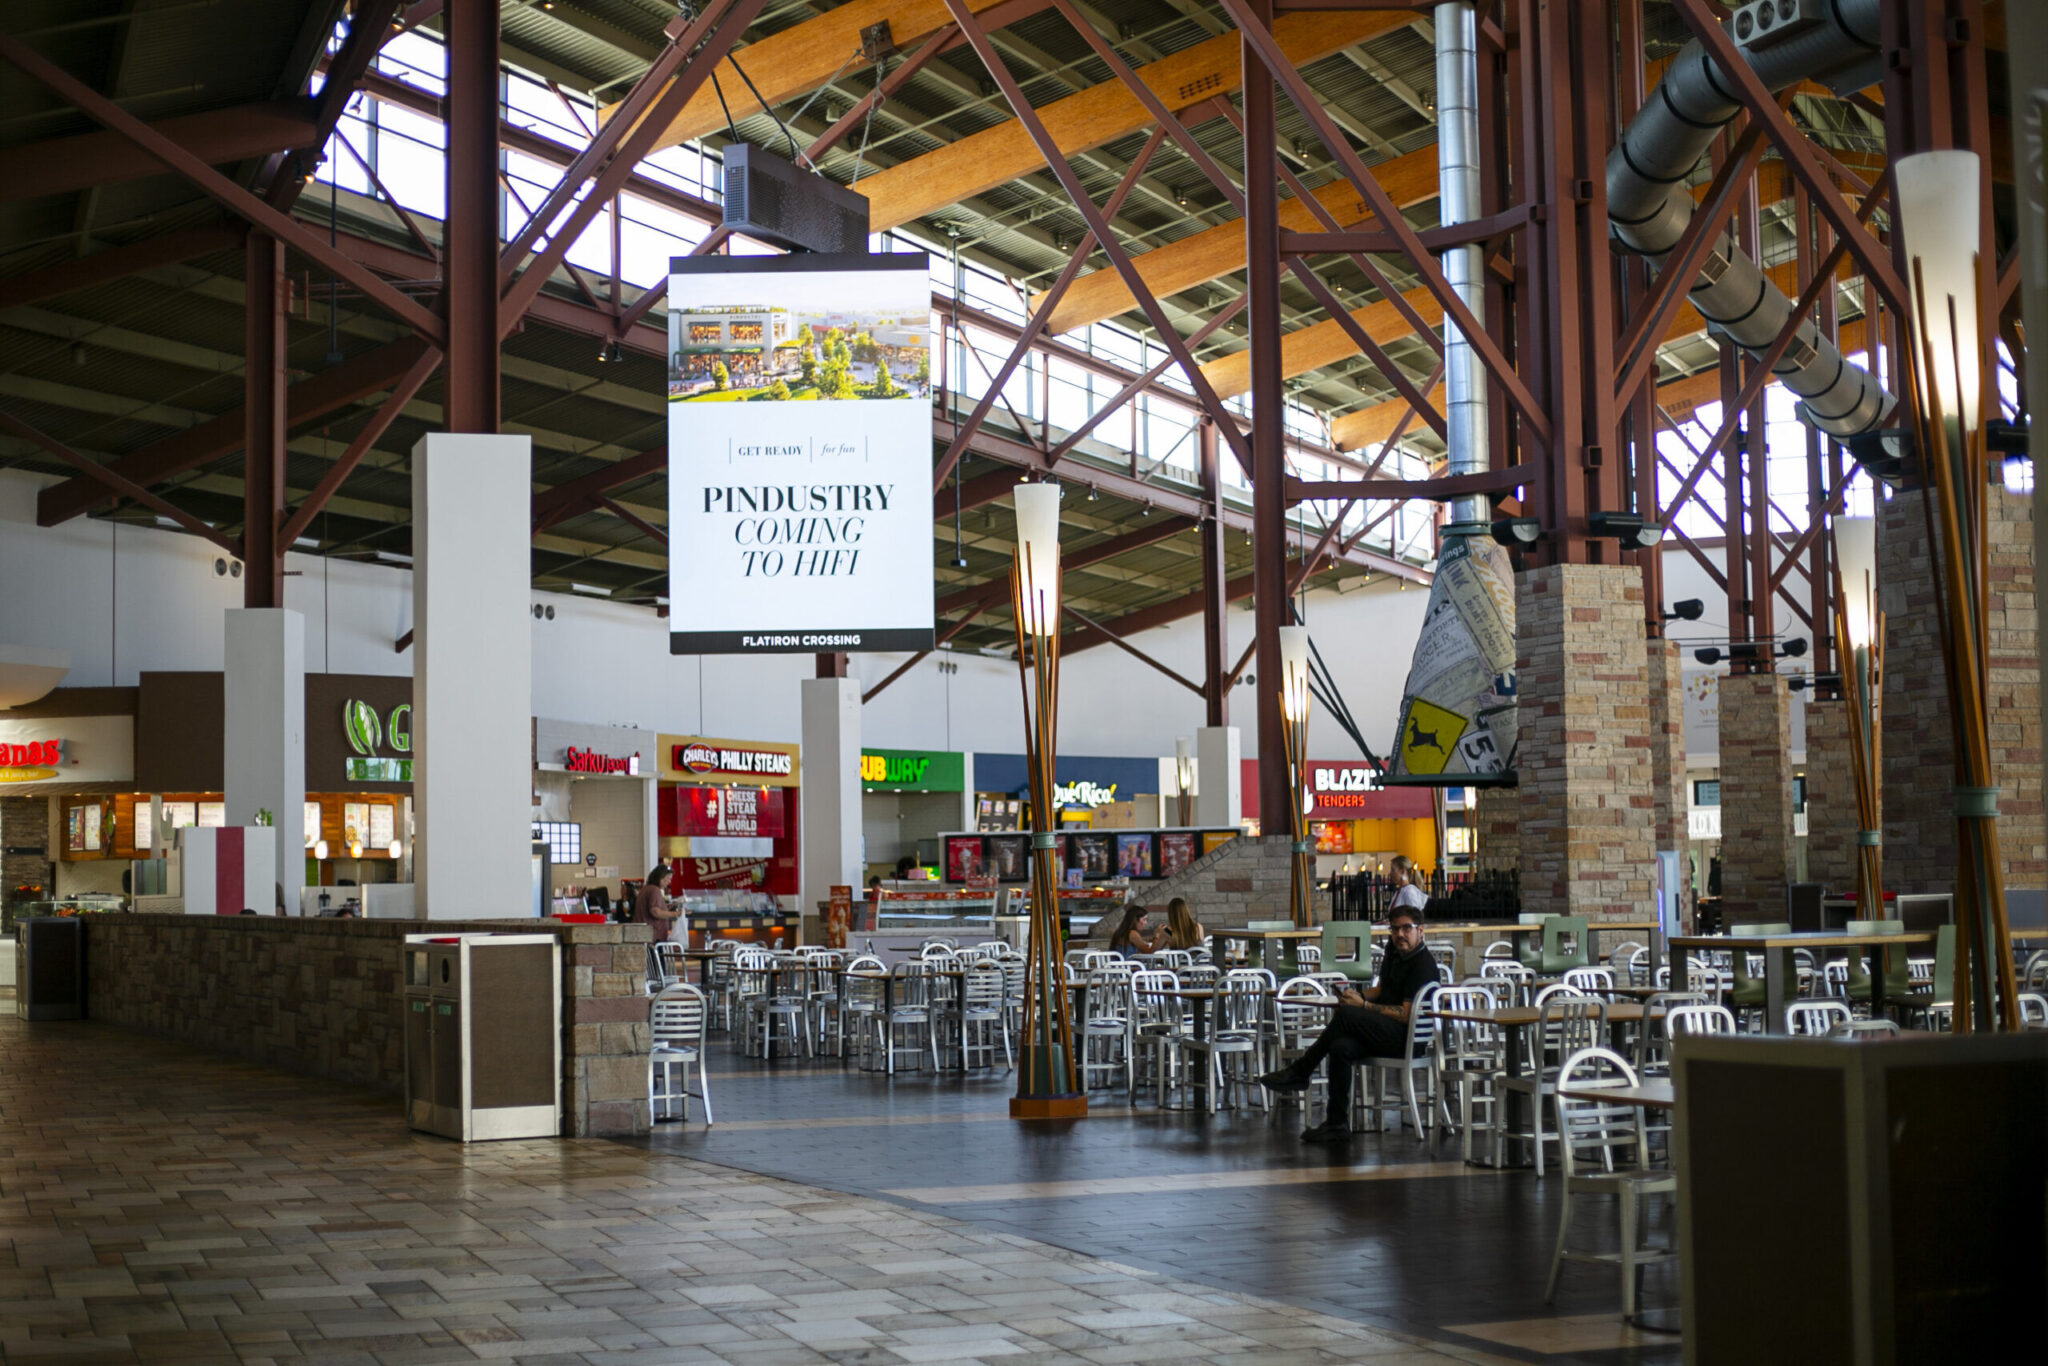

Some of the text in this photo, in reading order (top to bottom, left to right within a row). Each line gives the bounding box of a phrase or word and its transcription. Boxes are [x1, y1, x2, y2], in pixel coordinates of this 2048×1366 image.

[738, 443, 856, 456] GET READY for fun
[702, 484, 894, 513] PINDUSTRY
[735, 516, 865, 545] COMING
[741, 549, 862, 577] TO HIFI
[743, 634, 861, 647] FLATIRON CROSSING
[566, 746, 604, 773] Sarku
[721, 750, 753, 771] PHILLY
[754, 752, 791, 774] STEAKS
[860, 755, 930, 783] UBWAY
[726, 791, 756, 802] CHEESE
[1076, 781, 1117, 808] Rico!
[1317, 795, 1365, 807] TENDERS
[727, 802, 757, 814] STEAK
[727, 820, 758, 831] WORLD
